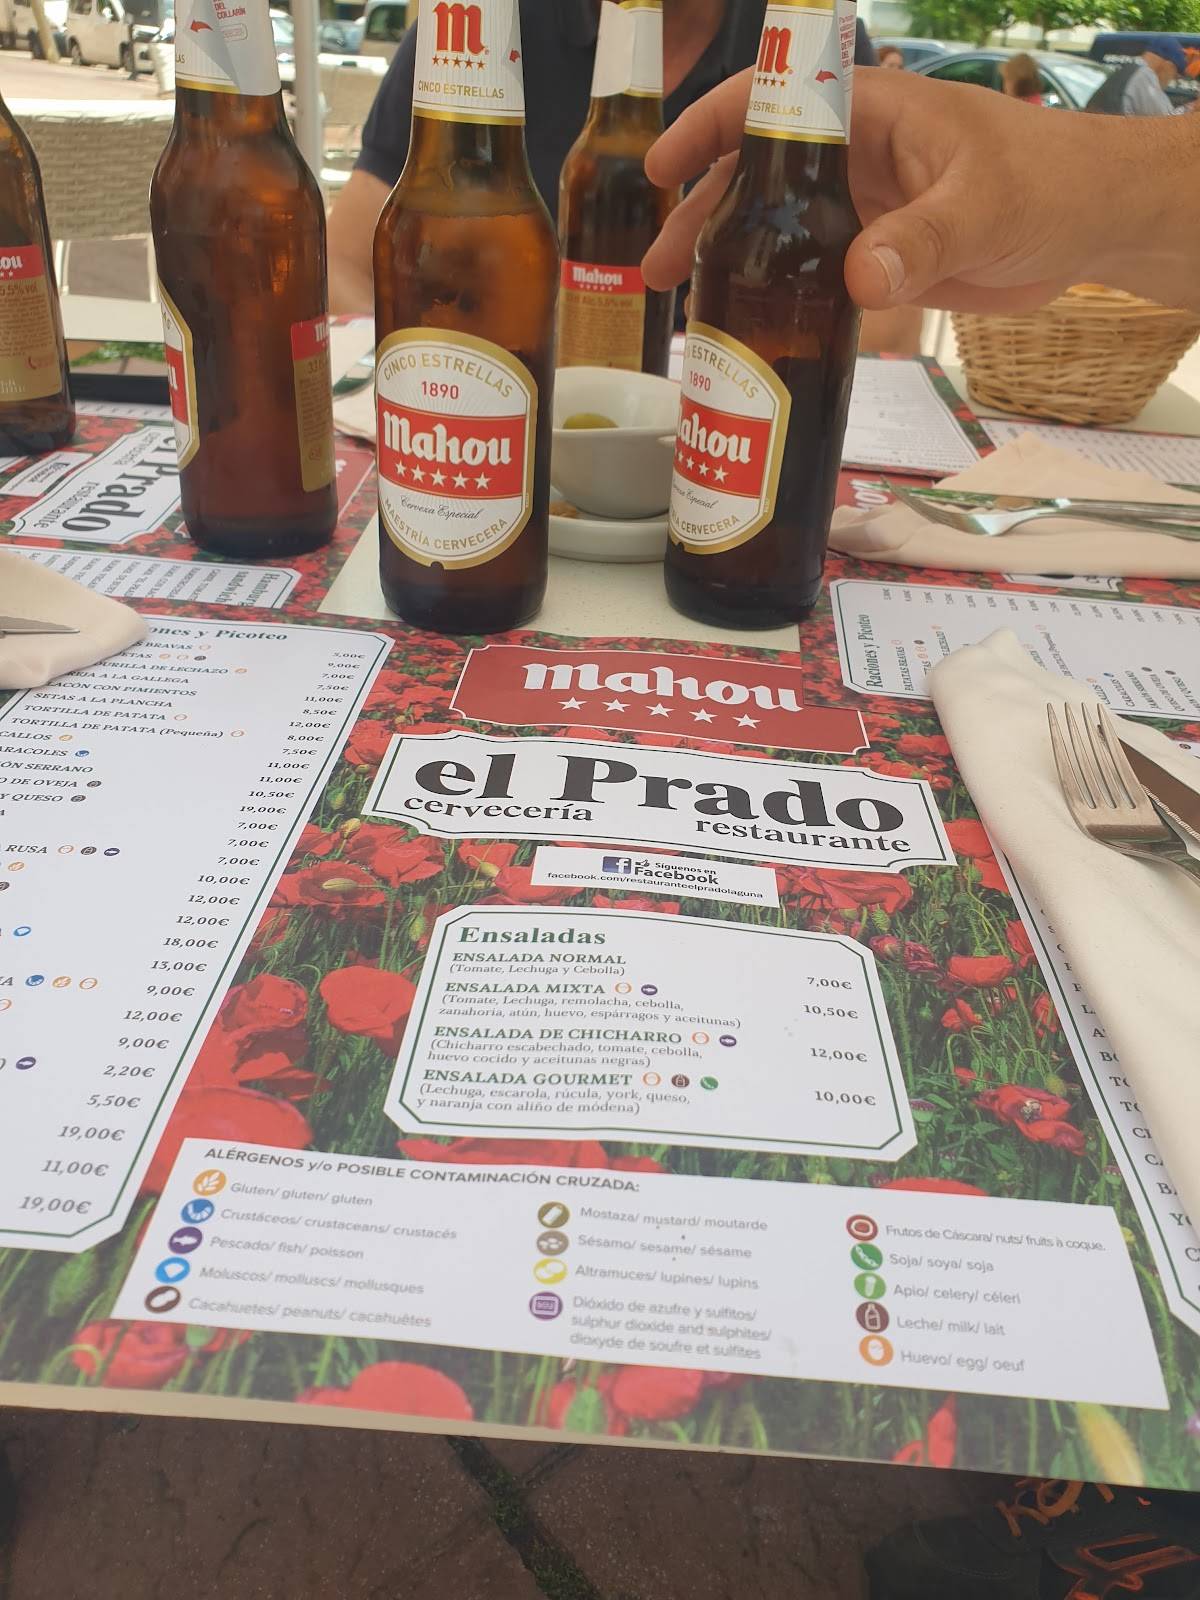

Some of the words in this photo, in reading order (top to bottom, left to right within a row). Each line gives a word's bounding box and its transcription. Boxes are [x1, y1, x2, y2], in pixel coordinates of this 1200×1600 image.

[418, 80, 441, 94] CINCO
[443, 83, 505, 99] ESTRELLAS
[753, 102, 802, 116] ESTRELLAS
[383, 353, 417, 380] CINCO
[420, 352, 513, 398] ESTRELLAS
[691, 343, 759, 399] ESTRELLAS
[689, 370, 711, 392] 1890
[421, 381, 459, 399] 1890
[399, 494, 436, 515] Cerveza
[435, 504, 484, 520] Especial
[384, 500, 430, 548] MAESTRÍA
[434, 519, 508, 550] CERVECERA
[681, 514, 740, 535] CERVECERA
[216, 630, 287, 640] Picoteo
[858, 614, 874, 641] Picoteo
[864, 649, 883, 688] Raciones
[24, 762, 93, 773] SERRANO
[11, 794, 63, 802] QUESO
[414, 753, 516, 800] el
[550, 754, 904, 833] Prado
[240, 806, 286, 814] 19,00€
[237, 822, 278, 830] 7,00€
[403, 796, 593, 822] cervecería
[695, 817, 911, 852] restaurante
[5, 844, 47, 854] RUSA
[228, 839, 269, 848] 7,00€
[218, 857, 260, 866] 7,00€
[655, 862, 701, 872] Síguenos
[703, 867, 717, 875] en
[198, 875, 250, 885] 10,00€
[634, 866, 719, 886] Facebook
[547, 872, 763, 898] facebook.com/restauranteelpradolaguna
[188, 895, 240, 905] 12,00€
[176, 916, 229, 926] 12,00€
[163, 938, 219, 948] 18,00€
[458, 927, 605, 944] Ensaladas
[452, 953, 544, 962] ENSALADA
[549, 953, 626, 964] NORMAL
[151, 961, 207, 972] 13,00€
[450, 963, 504, 973] (Tomate,
[508, 965, 558, 975] Lechuga
[573, 965, 625, 976] Cebolla)
[147, 985, 195, 996] 9,00€
[445, 982, 540, 993] ENSALADA
[545, 984, 605, 994] MIXTA
[807, 977, 852, 990] 7,00€
[442, 994, 498, 1005] (Tomate,
[503, 995, 557, 1007] Lechuga,
[562, 996, 631, 1008] remolacha,
[635, 999, 683, 1011] cebolla,
[124, 1010, 183, 1022] 12,00€
[439, 1007, 505, 1018] zanahoria,
[509, 1010, 540, 1018] atún,
[544, 1008, 587, 1018] huevo,
[590, 1009, 659, 1022] espárragos
[675, 1016, 741, 1029] aceitunas)
[804, 1005, 858, 1019] 10,50€
[434, 1026, 534, 1039] ENSALADA
[568, 1029, 682, 1044] CHICHARRO
[119, 1037, 169, 1049] 9,00€
[431, 1039, 503, 1051] (Chicharro
[507, 1042, 594, 1053] escabechado,
[598, 1044, 647, 1055] tomate,
[651, 1046, 702, 1059] cebolla,
[427, 1050, 469, 1062] huevo
[473, 1054, 517, 1063] cocido
[533, 1054, 597, 1064] aceitunas
[601, 1056, 651, 1068] negras)
[811, 1048, 867, 1062] 12,00€
[103, 1065, 155, 1078] 2,20€
[423, 1069, 527, 1084] ENSALADA
[533, 1073, 633, 1085] GOURMET
[417, 1082, 485, 1098] (Lechuga,
[490, 1088, 550, 1100] escarola,
[555, 1088, 602, 1100] rúcula,
[607, 1089, 642, 1101] york,
[646, 1093, 690, 1104] queso,
[816, 1091, 876, 1106] 10,00€
[86, 1094, 141, 1108] 5,50€
[429, 1099, 482, 1112] naranja
[516, 1101, 552, 1112] aliño
[578, 1101, 640, 1115] módena)
[59, 1126, 125, 1141] 19,00€
[204, 1148, 304, 1168] ALÉRGENOS
[41, 1160, 109, 1177] 11,00€
[19, 1196, 92, 1214] 19,00€
